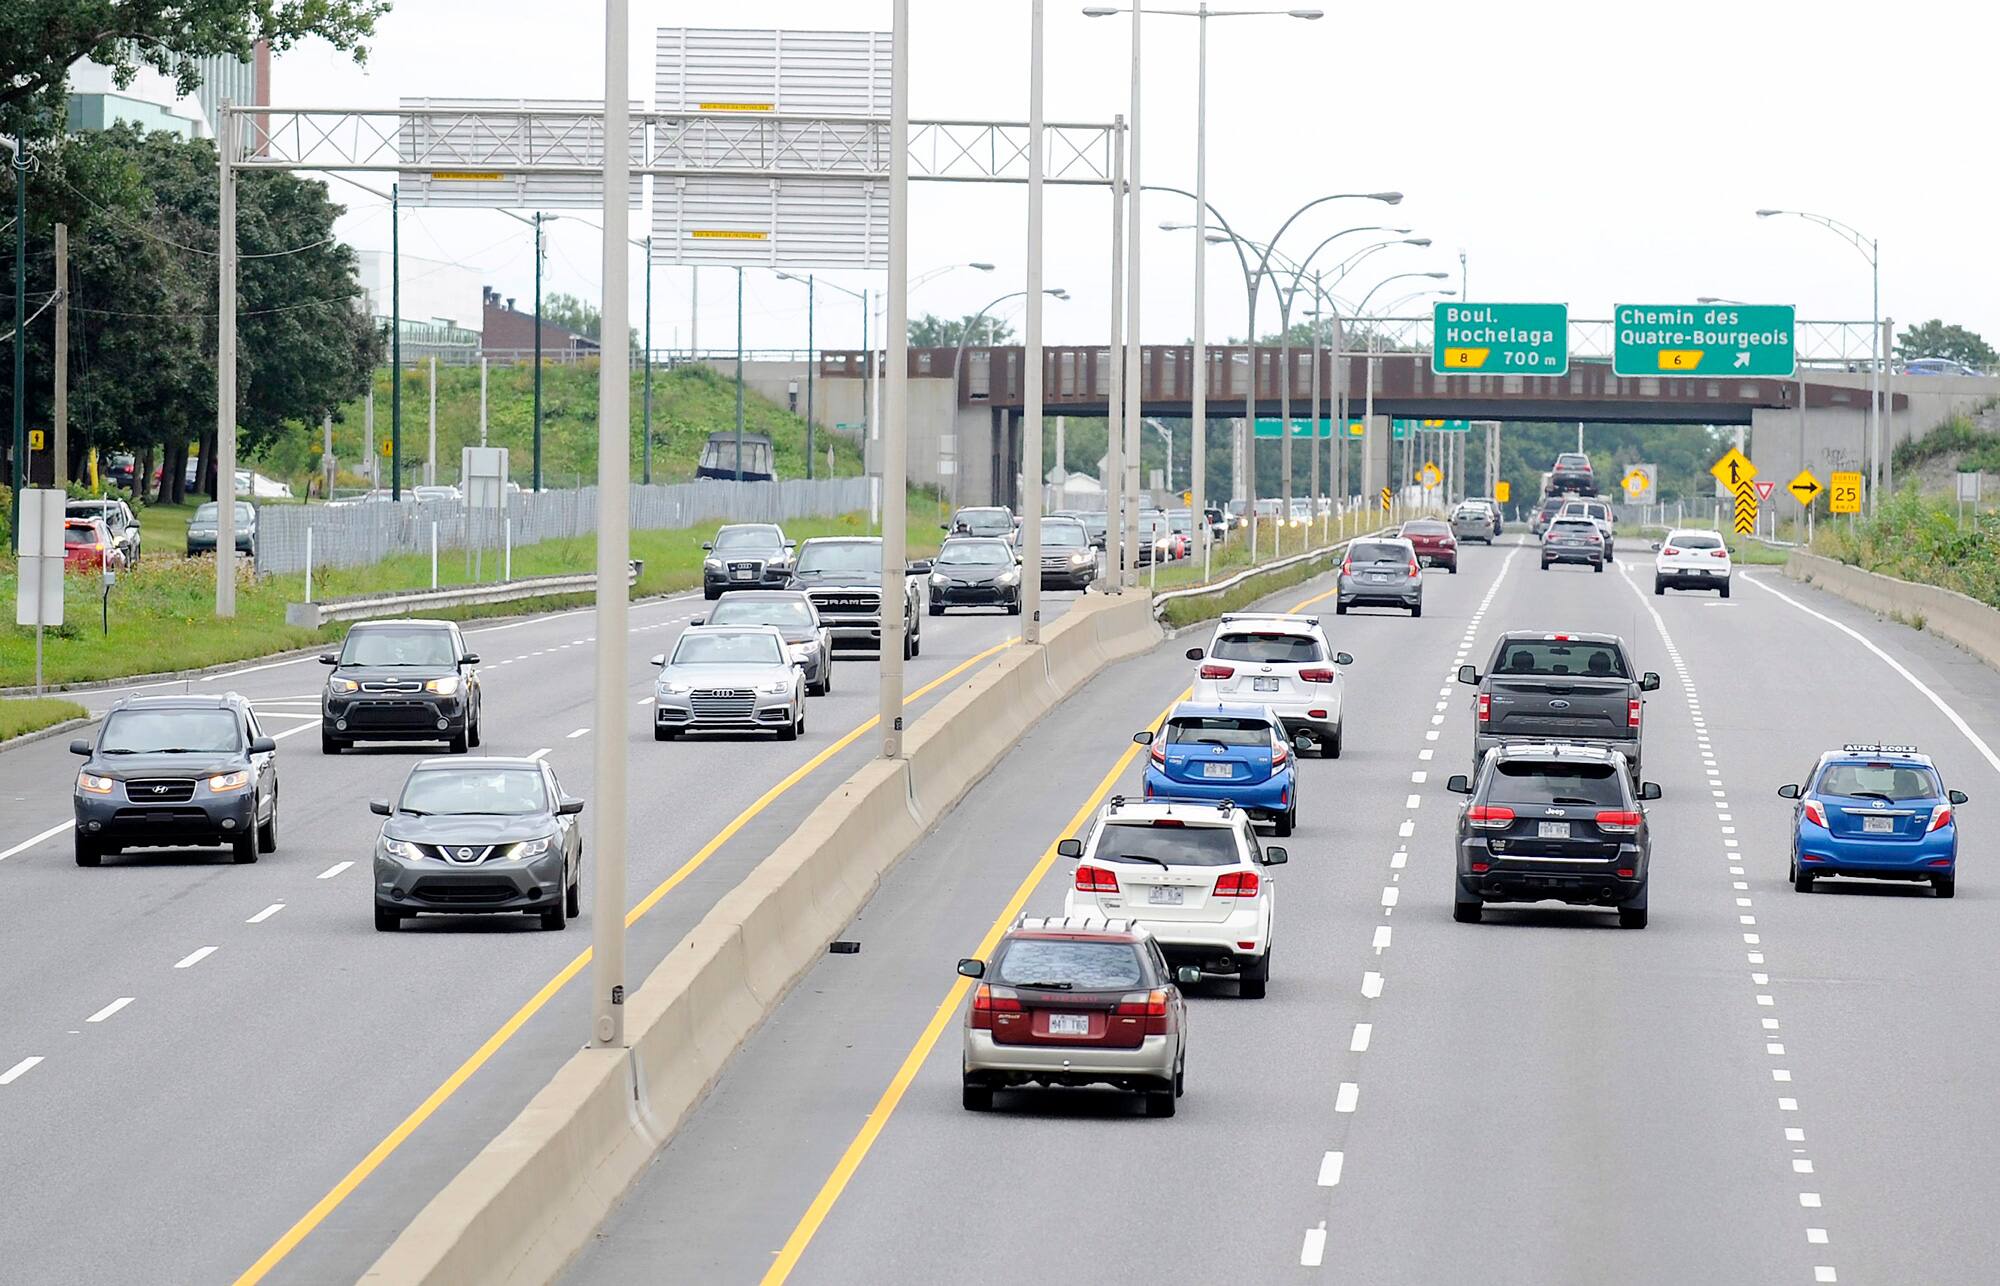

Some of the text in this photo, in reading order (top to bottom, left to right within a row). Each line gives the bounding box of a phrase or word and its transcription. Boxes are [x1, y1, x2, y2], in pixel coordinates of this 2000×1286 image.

[1447, 307, 1498, 323] Boul.
[1621, 309, 1739, 325] Chemin des
[1447, 327, 1553, 346] Hochelaga
[1621, 330, 1789, 348] Quatre-Bourgeois
[1460, 352, 1468, 363] 8
[1503, 351, 1556, 365] 700 m
[1674, 355, 1682, 365] 6
[1835, 487, 1856, 502] 25
[1544, 807, 1565, 817] Jeep
